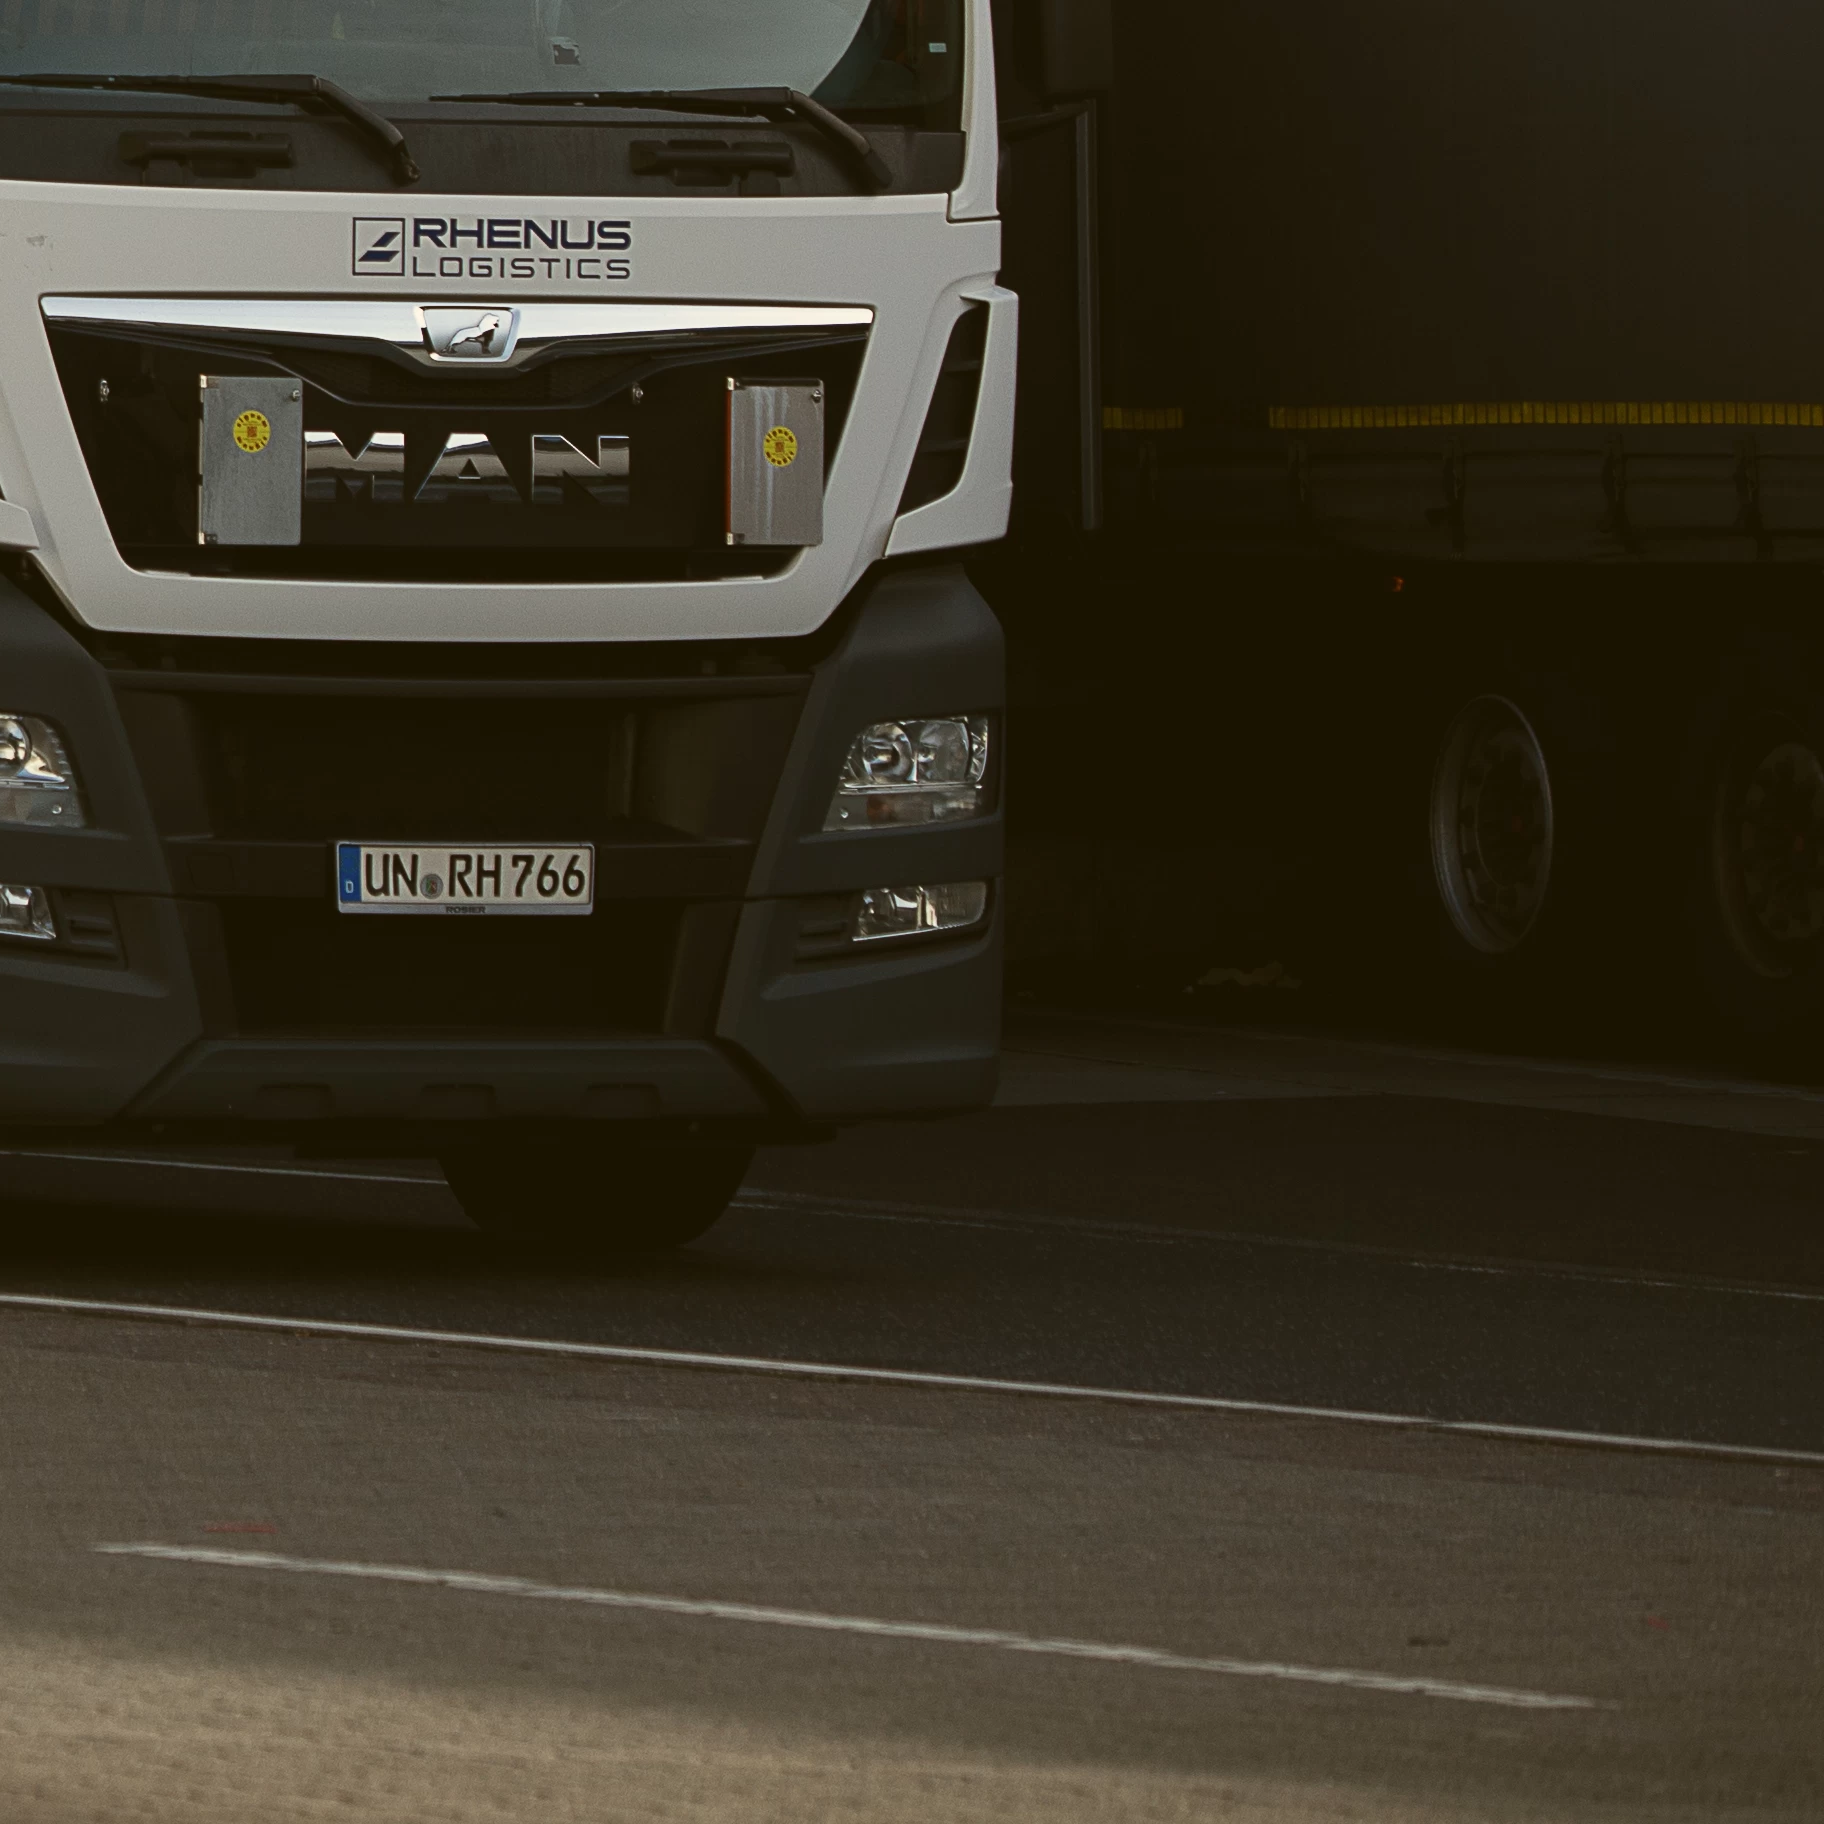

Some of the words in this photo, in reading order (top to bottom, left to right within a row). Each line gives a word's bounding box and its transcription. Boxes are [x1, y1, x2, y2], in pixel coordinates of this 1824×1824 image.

[412, 217, 632, 251] RHENUS
[412, 256, 631, 280] LOGISTICS
[304, 431, 630, 504] MAN
[345, 879, 354, 894] D
[365, 853, 419, 897] UN
[448, 853, 501, 898] RH
[511, 854, 586, 898] 766
